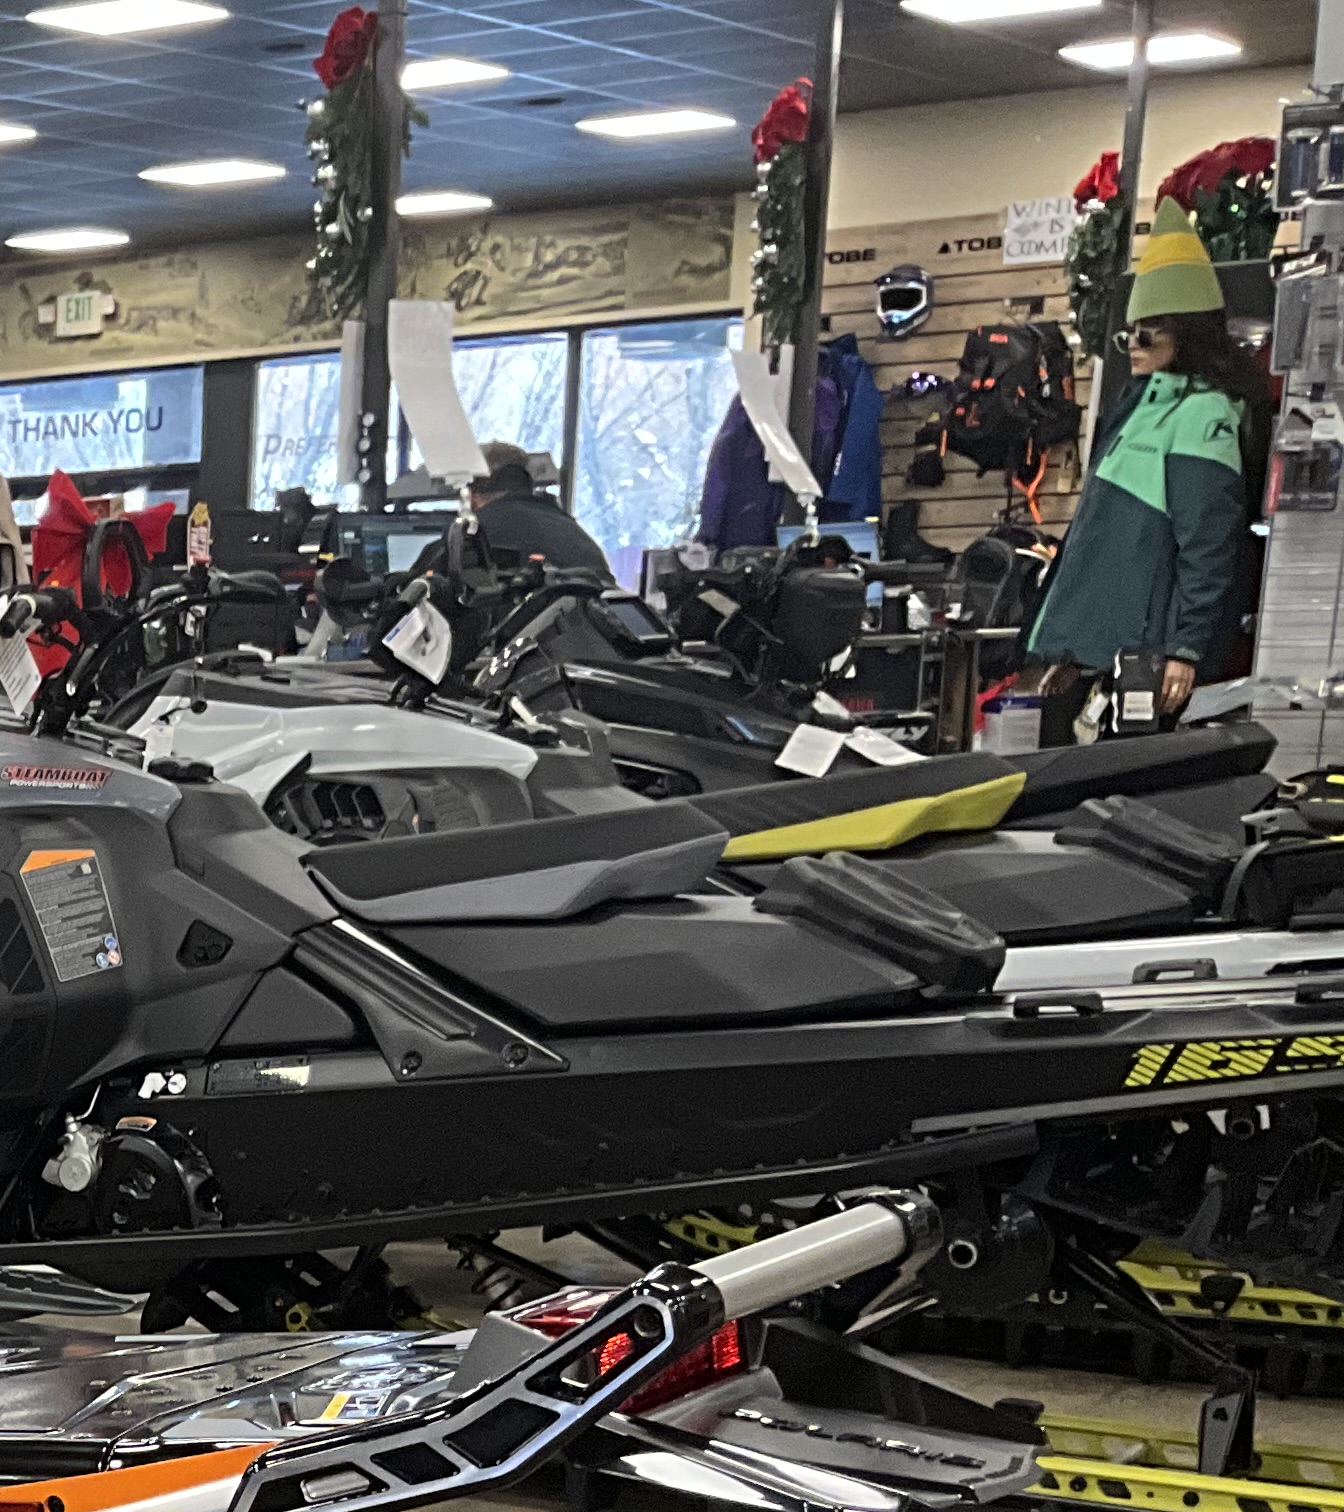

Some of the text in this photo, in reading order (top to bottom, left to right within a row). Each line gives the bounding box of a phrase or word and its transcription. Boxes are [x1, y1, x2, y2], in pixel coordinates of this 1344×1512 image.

[954, 235, 1003, 252] TOB
[825, 247, 877, 265] OBE
[64, 296, 94, 324] EXIT
[7, 405, 164, 444] THANK YOU
[0, 765, 112, 782] STEAMBOAT
